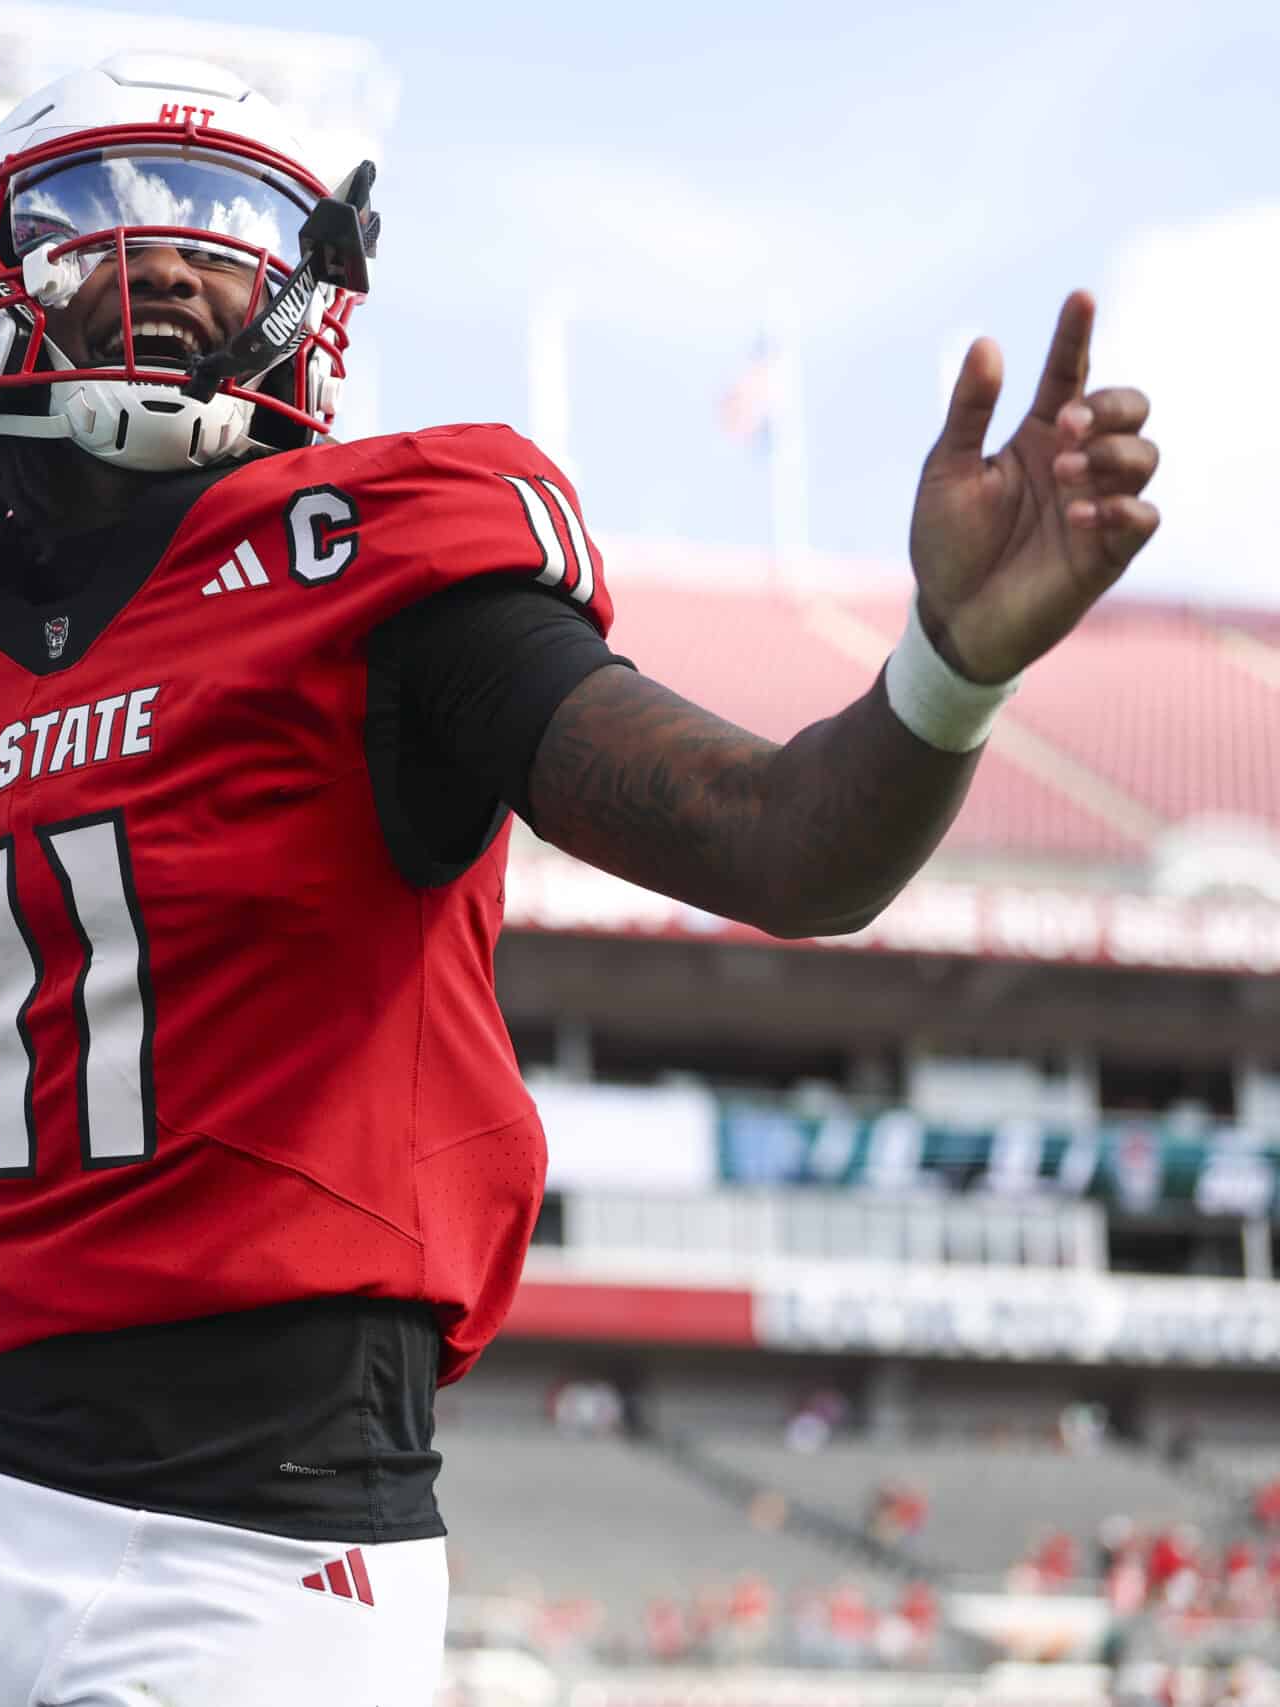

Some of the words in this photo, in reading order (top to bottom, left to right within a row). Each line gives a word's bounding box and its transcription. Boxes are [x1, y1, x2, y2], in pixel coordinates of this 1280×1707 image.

[159, 103, 215, 129] HTT
[284, 483, 359, 587] C
[498, 474, 595, 606] 11
